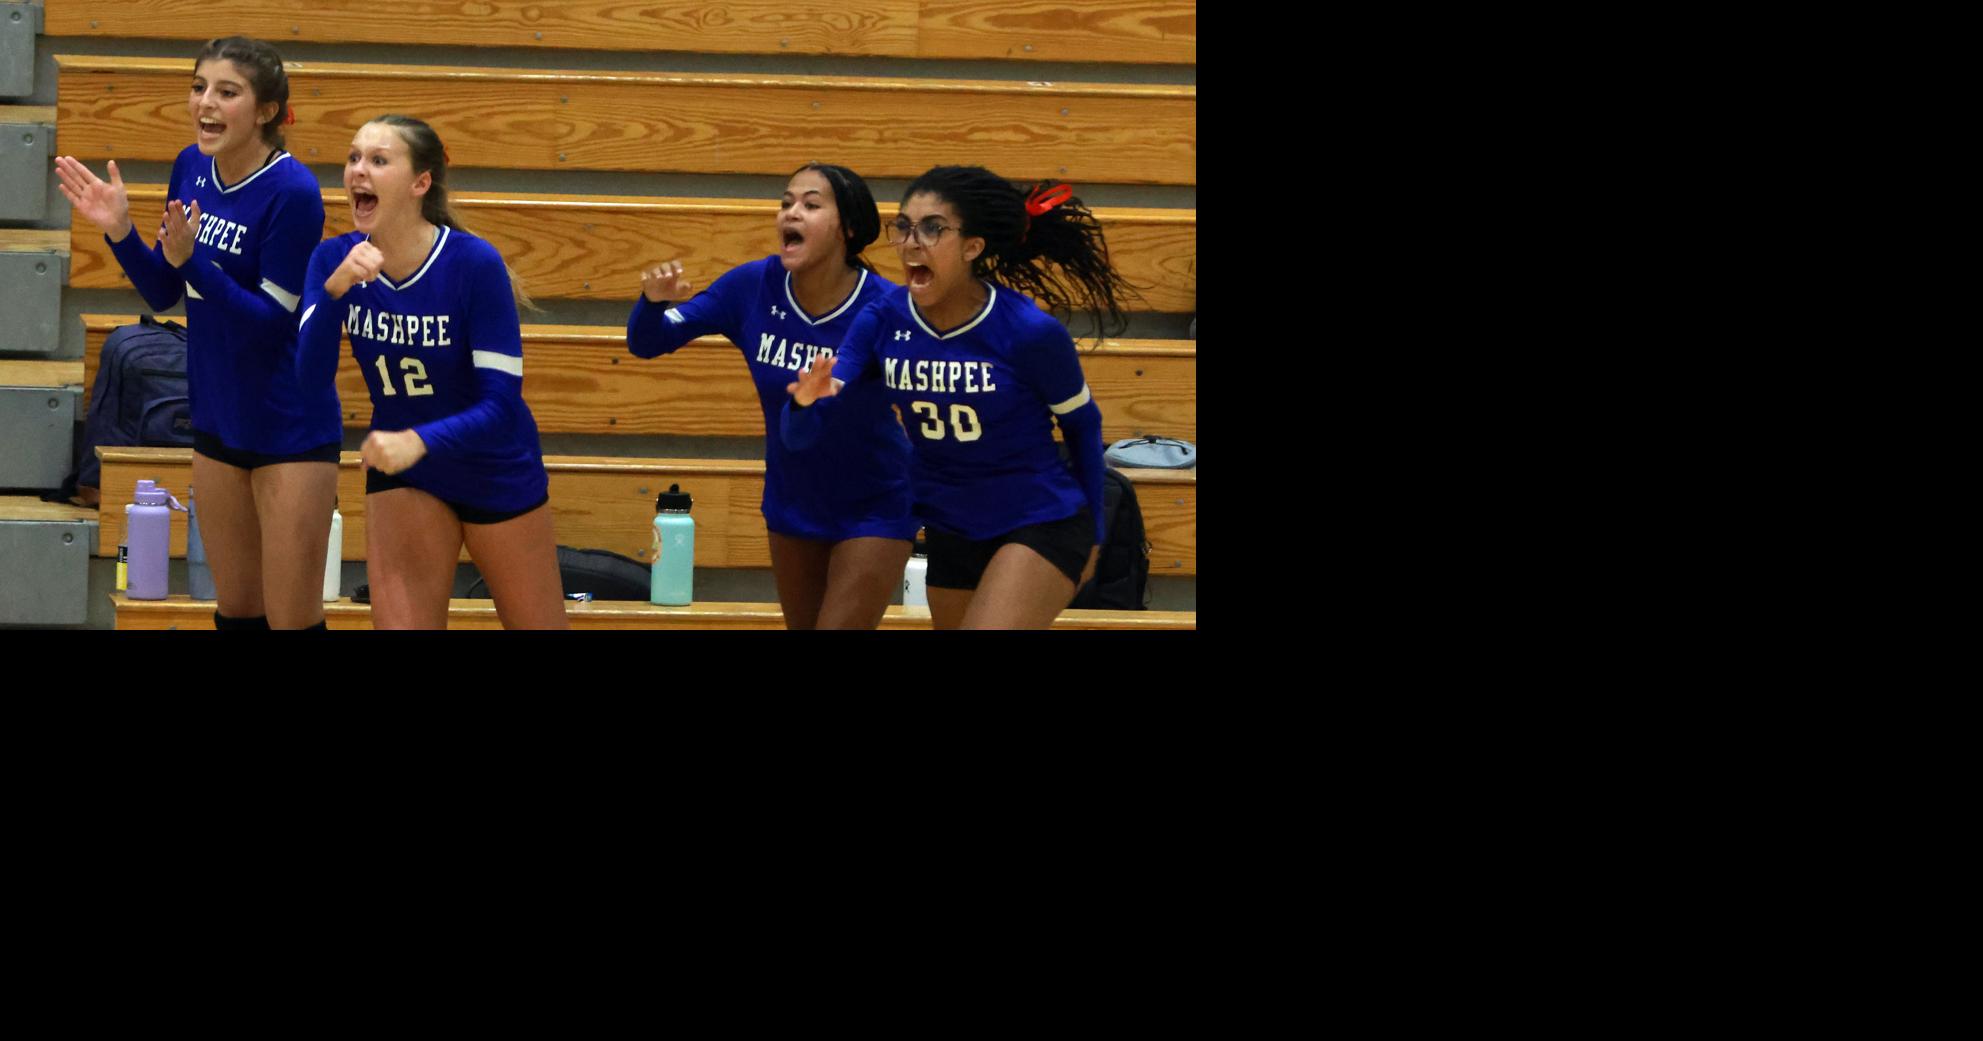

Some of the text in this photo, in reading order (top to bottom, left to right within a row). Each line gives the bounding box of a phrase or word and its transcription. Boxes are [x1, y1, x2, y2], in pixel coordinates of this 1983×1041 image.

[347, 303, 452, 347] MASHPEE
[375, 354, 434, 396] 12
[885, 357, 996, 393] MASHPEE
[911, 401, 982, 442] 30
